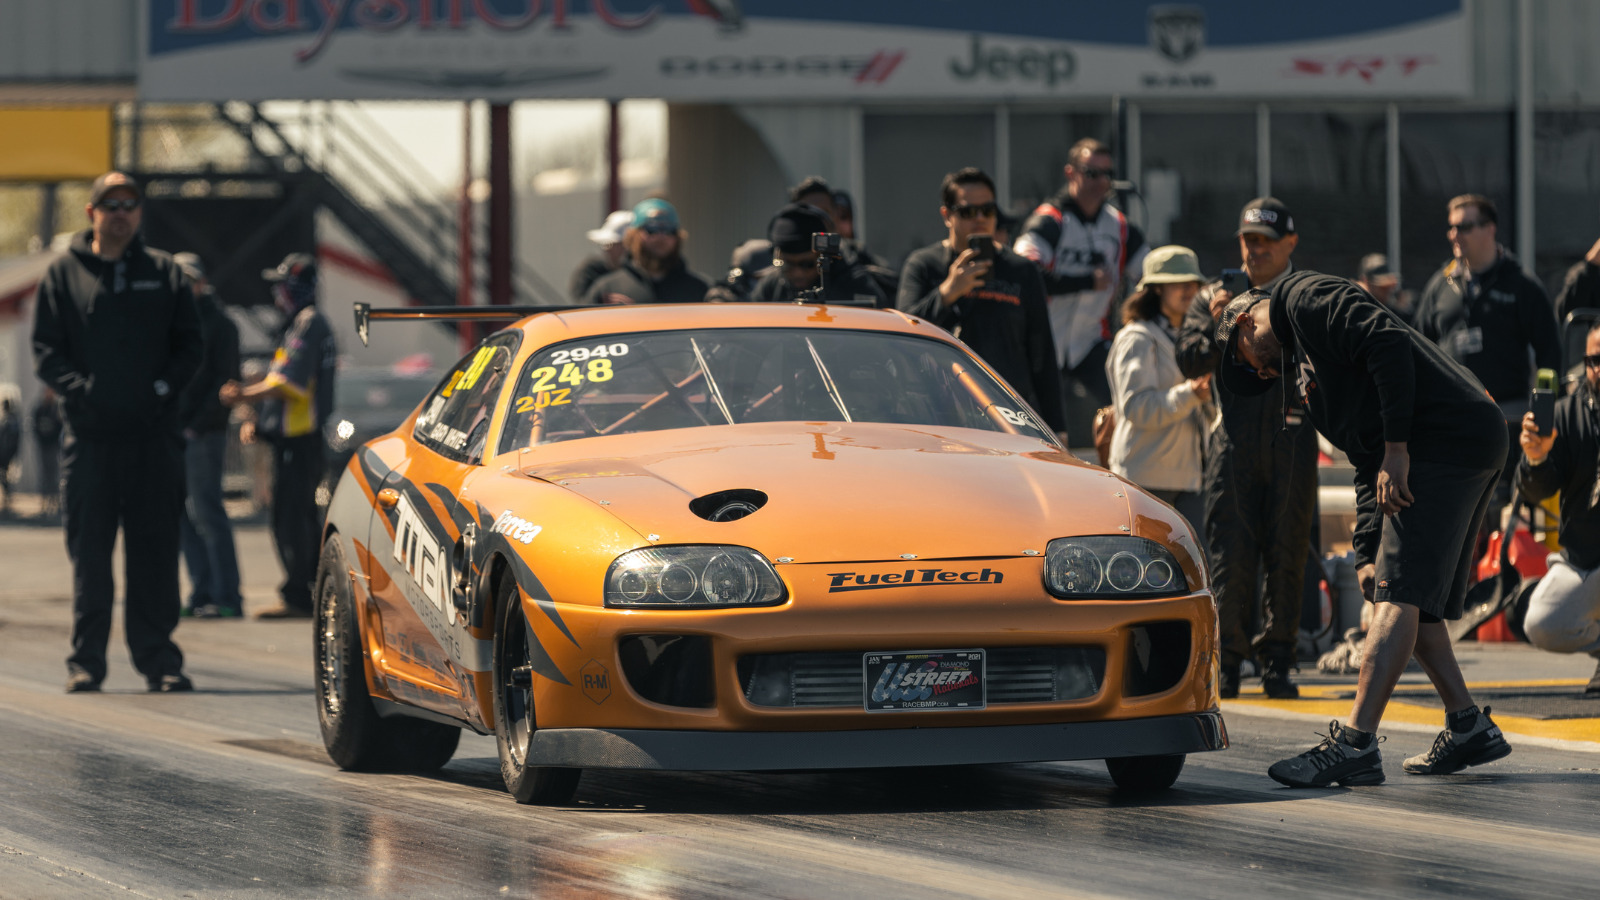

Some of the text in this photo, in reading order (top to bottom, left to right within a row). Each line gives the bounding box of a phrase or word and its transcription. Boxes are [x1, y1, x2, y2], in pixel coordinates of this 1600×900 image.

[946, 34, 1078, 86] Jeep
[550, 343, 629, 366] 2940
[531, 358, 614, 393] 248
[516, 388, 572, 414] 2JZ
[489, 509, 543, 545] Ferrea
[826, 568, 1004, 587] FuelTech
[584, 674, 608, 689] R-M
[900, 671, 973, 686] STREET
[933, 674, 979, 695] Nationals
